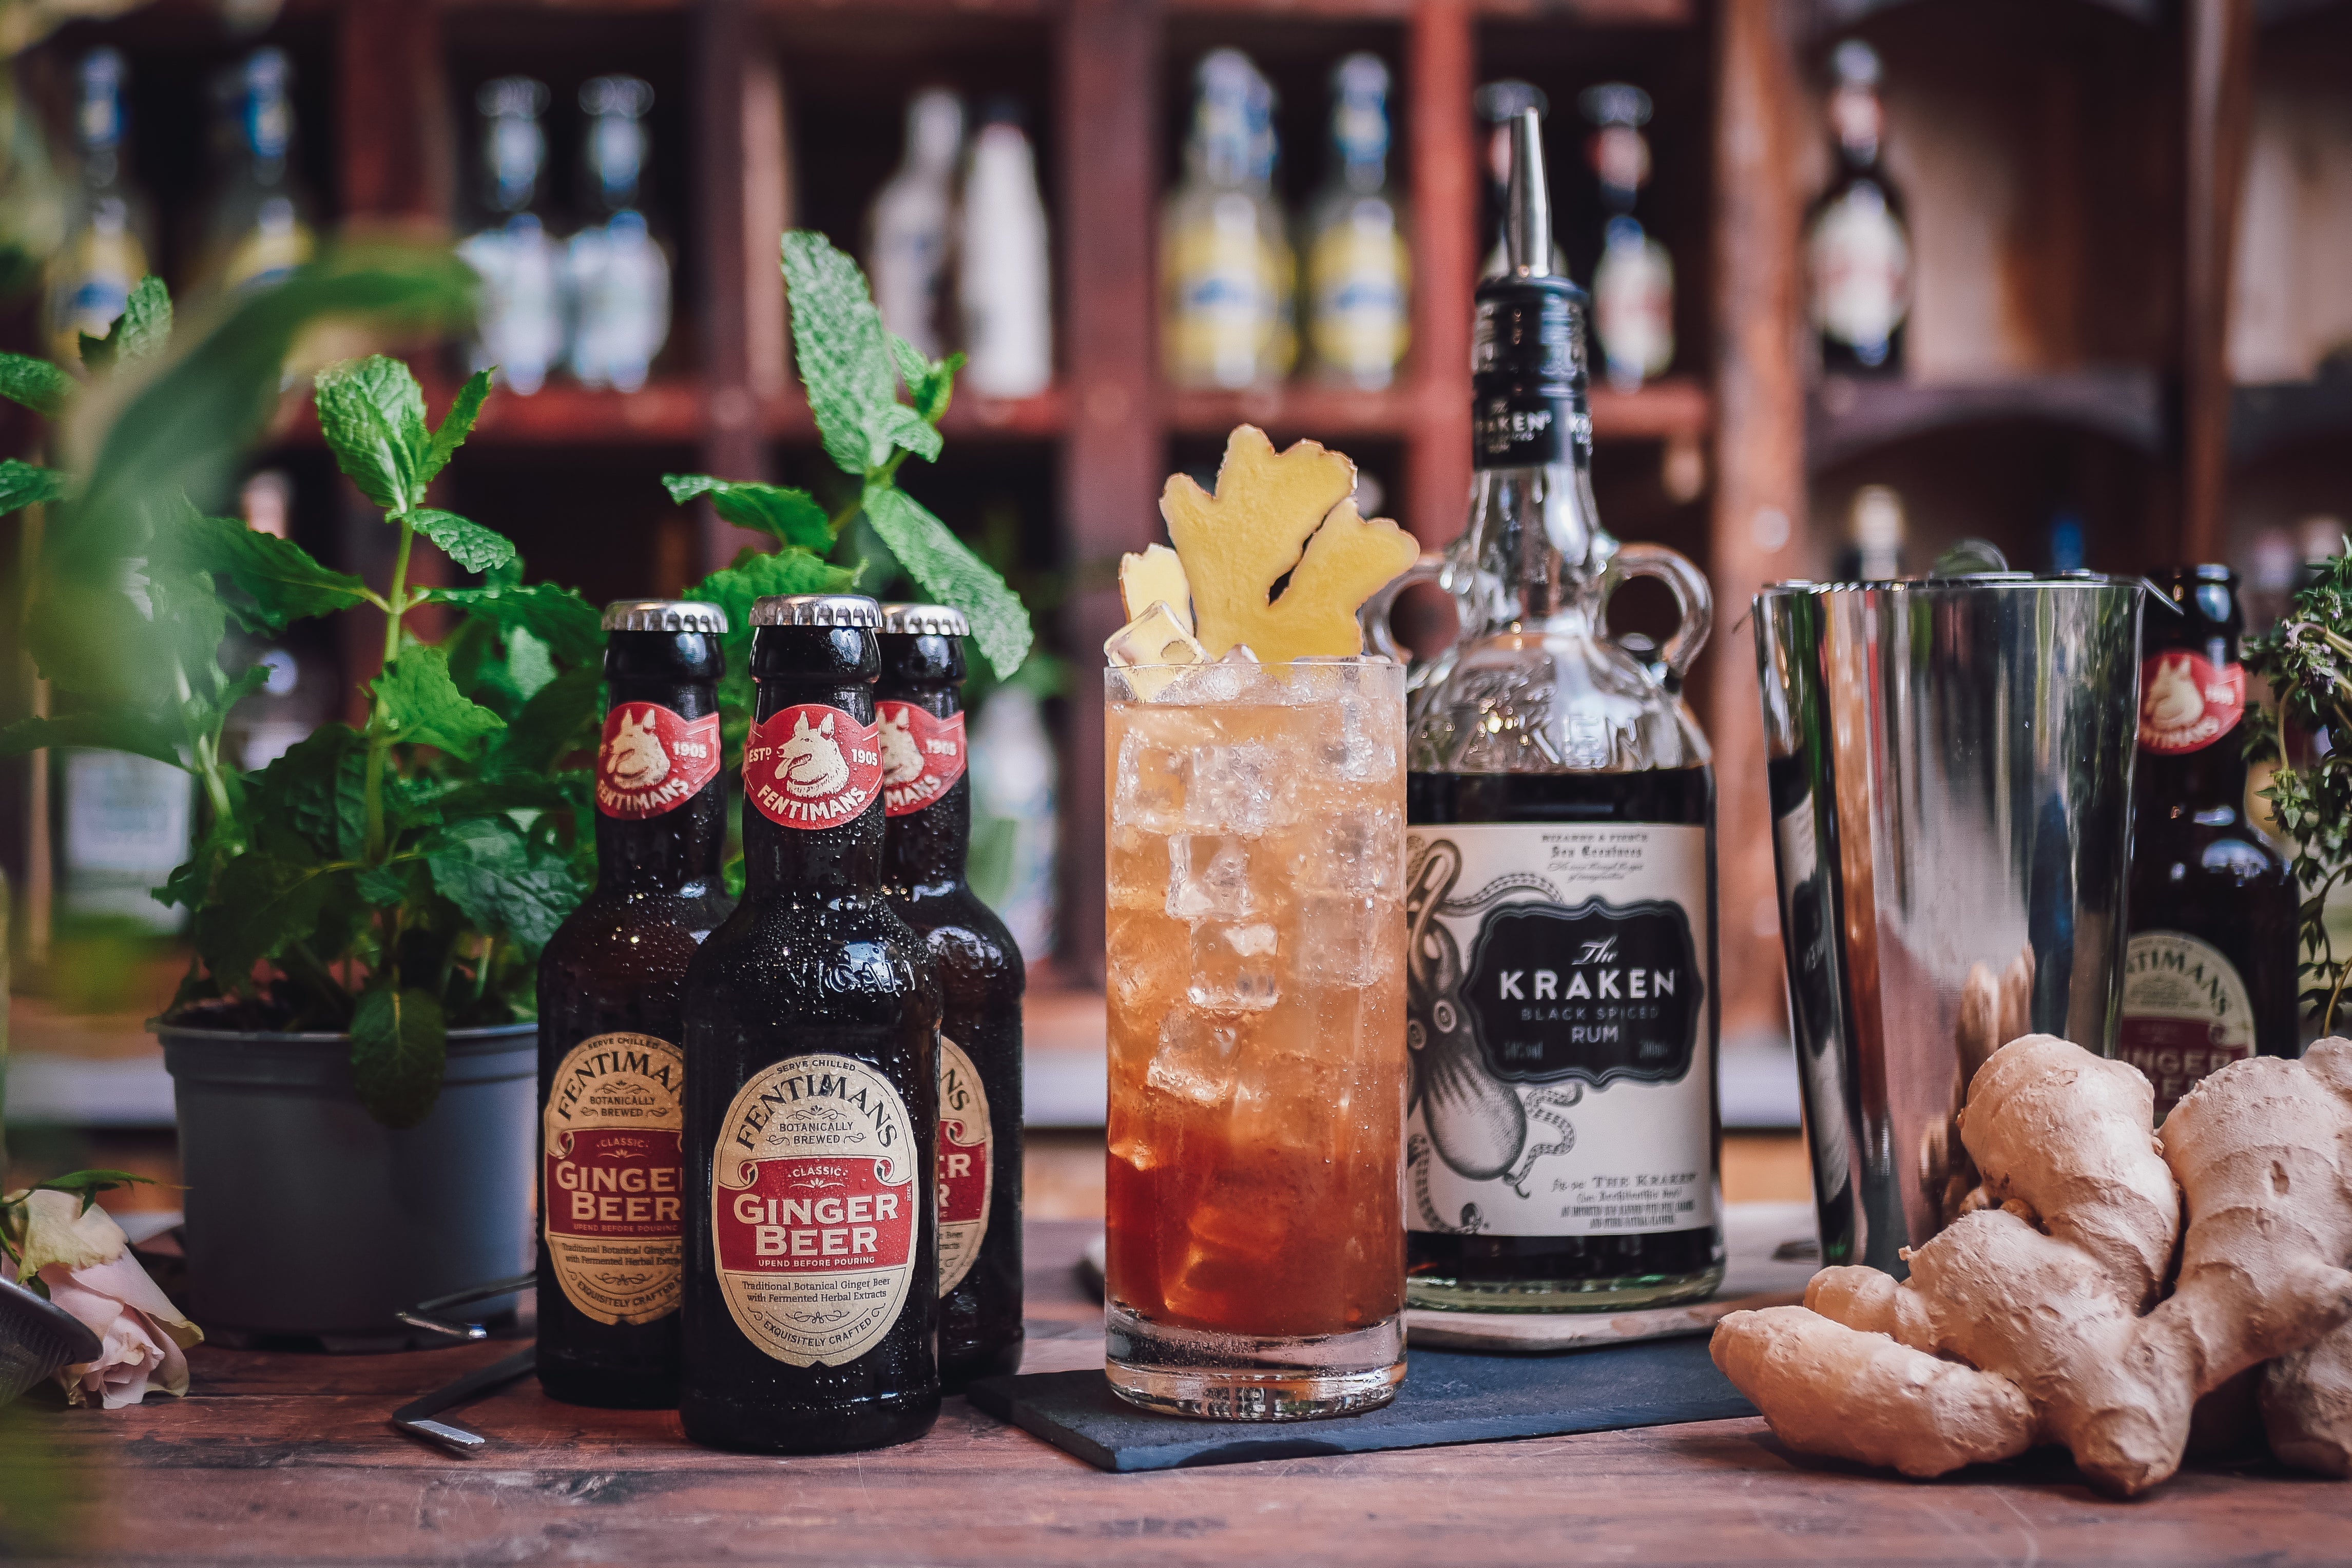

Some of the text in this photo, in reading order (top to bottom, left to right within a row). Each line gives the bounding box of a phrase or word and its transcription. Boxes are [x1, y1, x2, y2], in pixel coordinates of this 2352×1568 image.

[673, 741, 707, 759] 1905
[852, 748, 878, 766] 1905
[757, 784, 866, 821] FENTIMANS
[1500, 967, 1675, 1000] KRAKEN
[1521, 1006, 1659, 1021] BLACK SPICED
[1572, 1025, 1618, 1043] RUM
[588, 1037, 659, 1050] SERVE CHILLED
[777, 1059, 856, 1074] SERVE CHILLED
[558, 1051, 683, 1121] FENTIMA
[590, 1096, 656, 1106] BOTANICALLY
[602, 1108, 643, 1117] BREWED
[736, 1074, 898, 1152] FENTIMANS
[779, 1122, 853, 1132] BOTANICALLY
[601, 1137, 645, 1148] CLASSIC
[794, 1135, 840, 1144] BREWED
[556, 1161, 682, 1192] GINGE
[793, 1166, 842, 1178] CLASSIC
[571, 1191, 681, 1222] BEER
[734, 1193, 898, 1225] GINGER
[755, 1225, 878, 1256] BEER
[602, 1246, 641, 1254] Botanical
[581, 1256, 623, 1265] Fermented
[759, 1256, 875, 1267] UPEND BEFORE POURING
[742, 1278, 891, 1291] Traditional Botanical Ginger Beer
[577, 1281, 676, 1307] EXQUISITELY CRAFTED
[747, 1290, 887, 1303] with Fermented Herbal Extracts
[763, 1317, 872, 1347] EXQUISITELY CRAFTED
